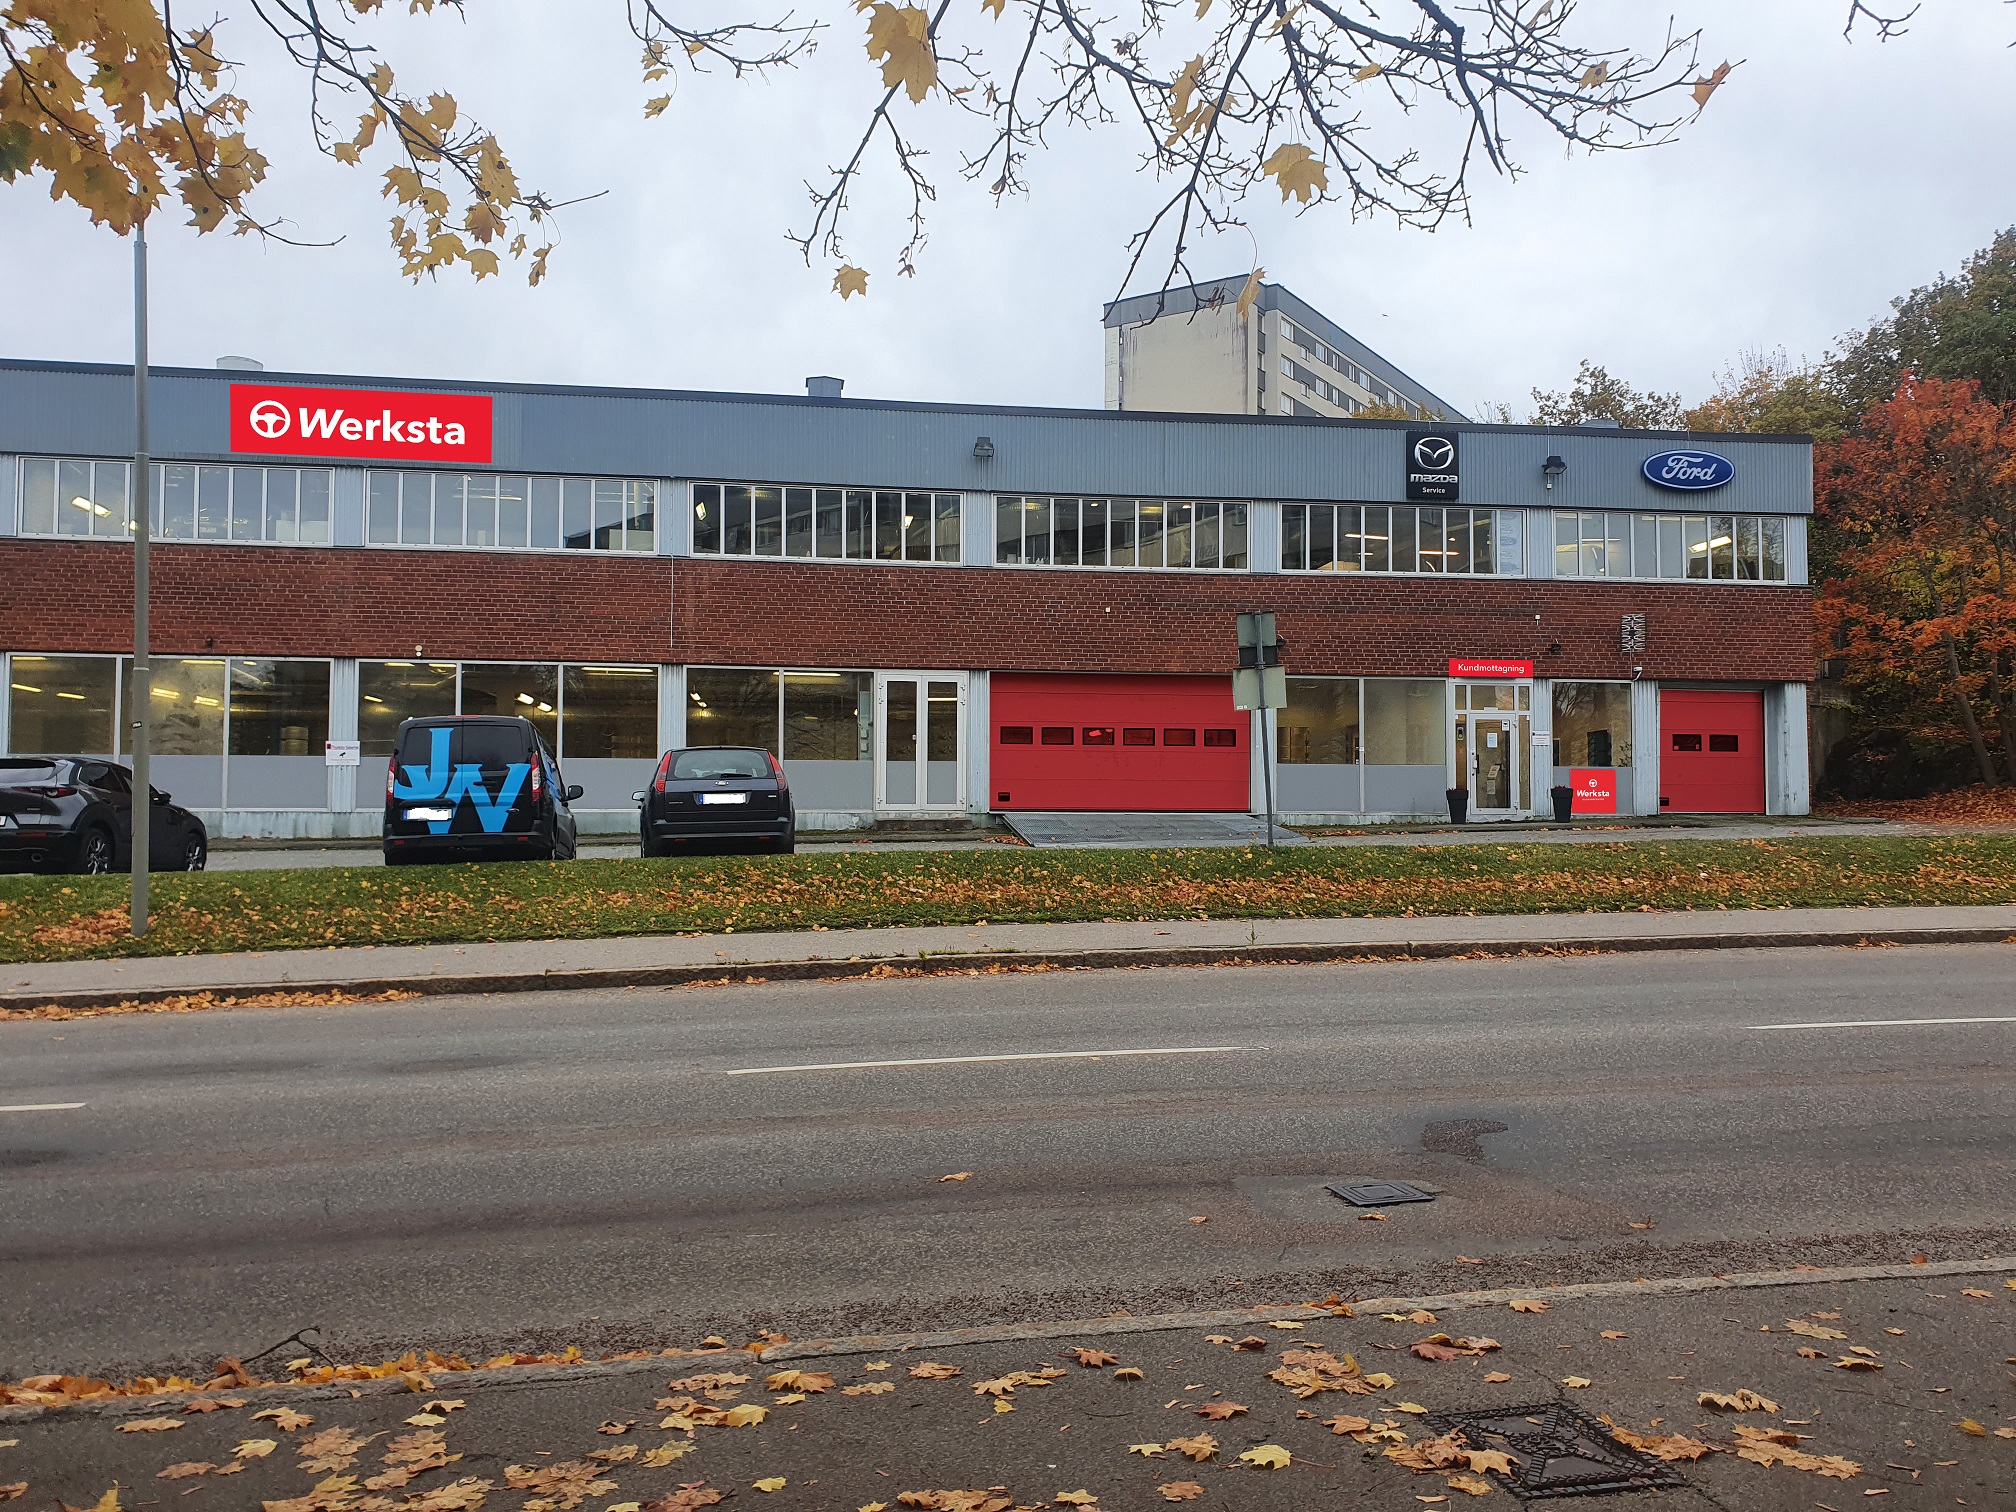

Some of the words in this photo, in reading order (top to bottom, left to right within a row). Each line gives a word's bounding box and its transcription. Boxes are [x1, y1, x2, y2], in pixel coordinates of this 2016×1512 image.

[298, 407, 466, 445] Werksta
[1661, 455, 1718, 481] Ford
[1422, 486, 1446, 494] Service
[1457, 663, 1525, 674] Kundmottagning
[1576, 789, 1610, 798] Werksta
